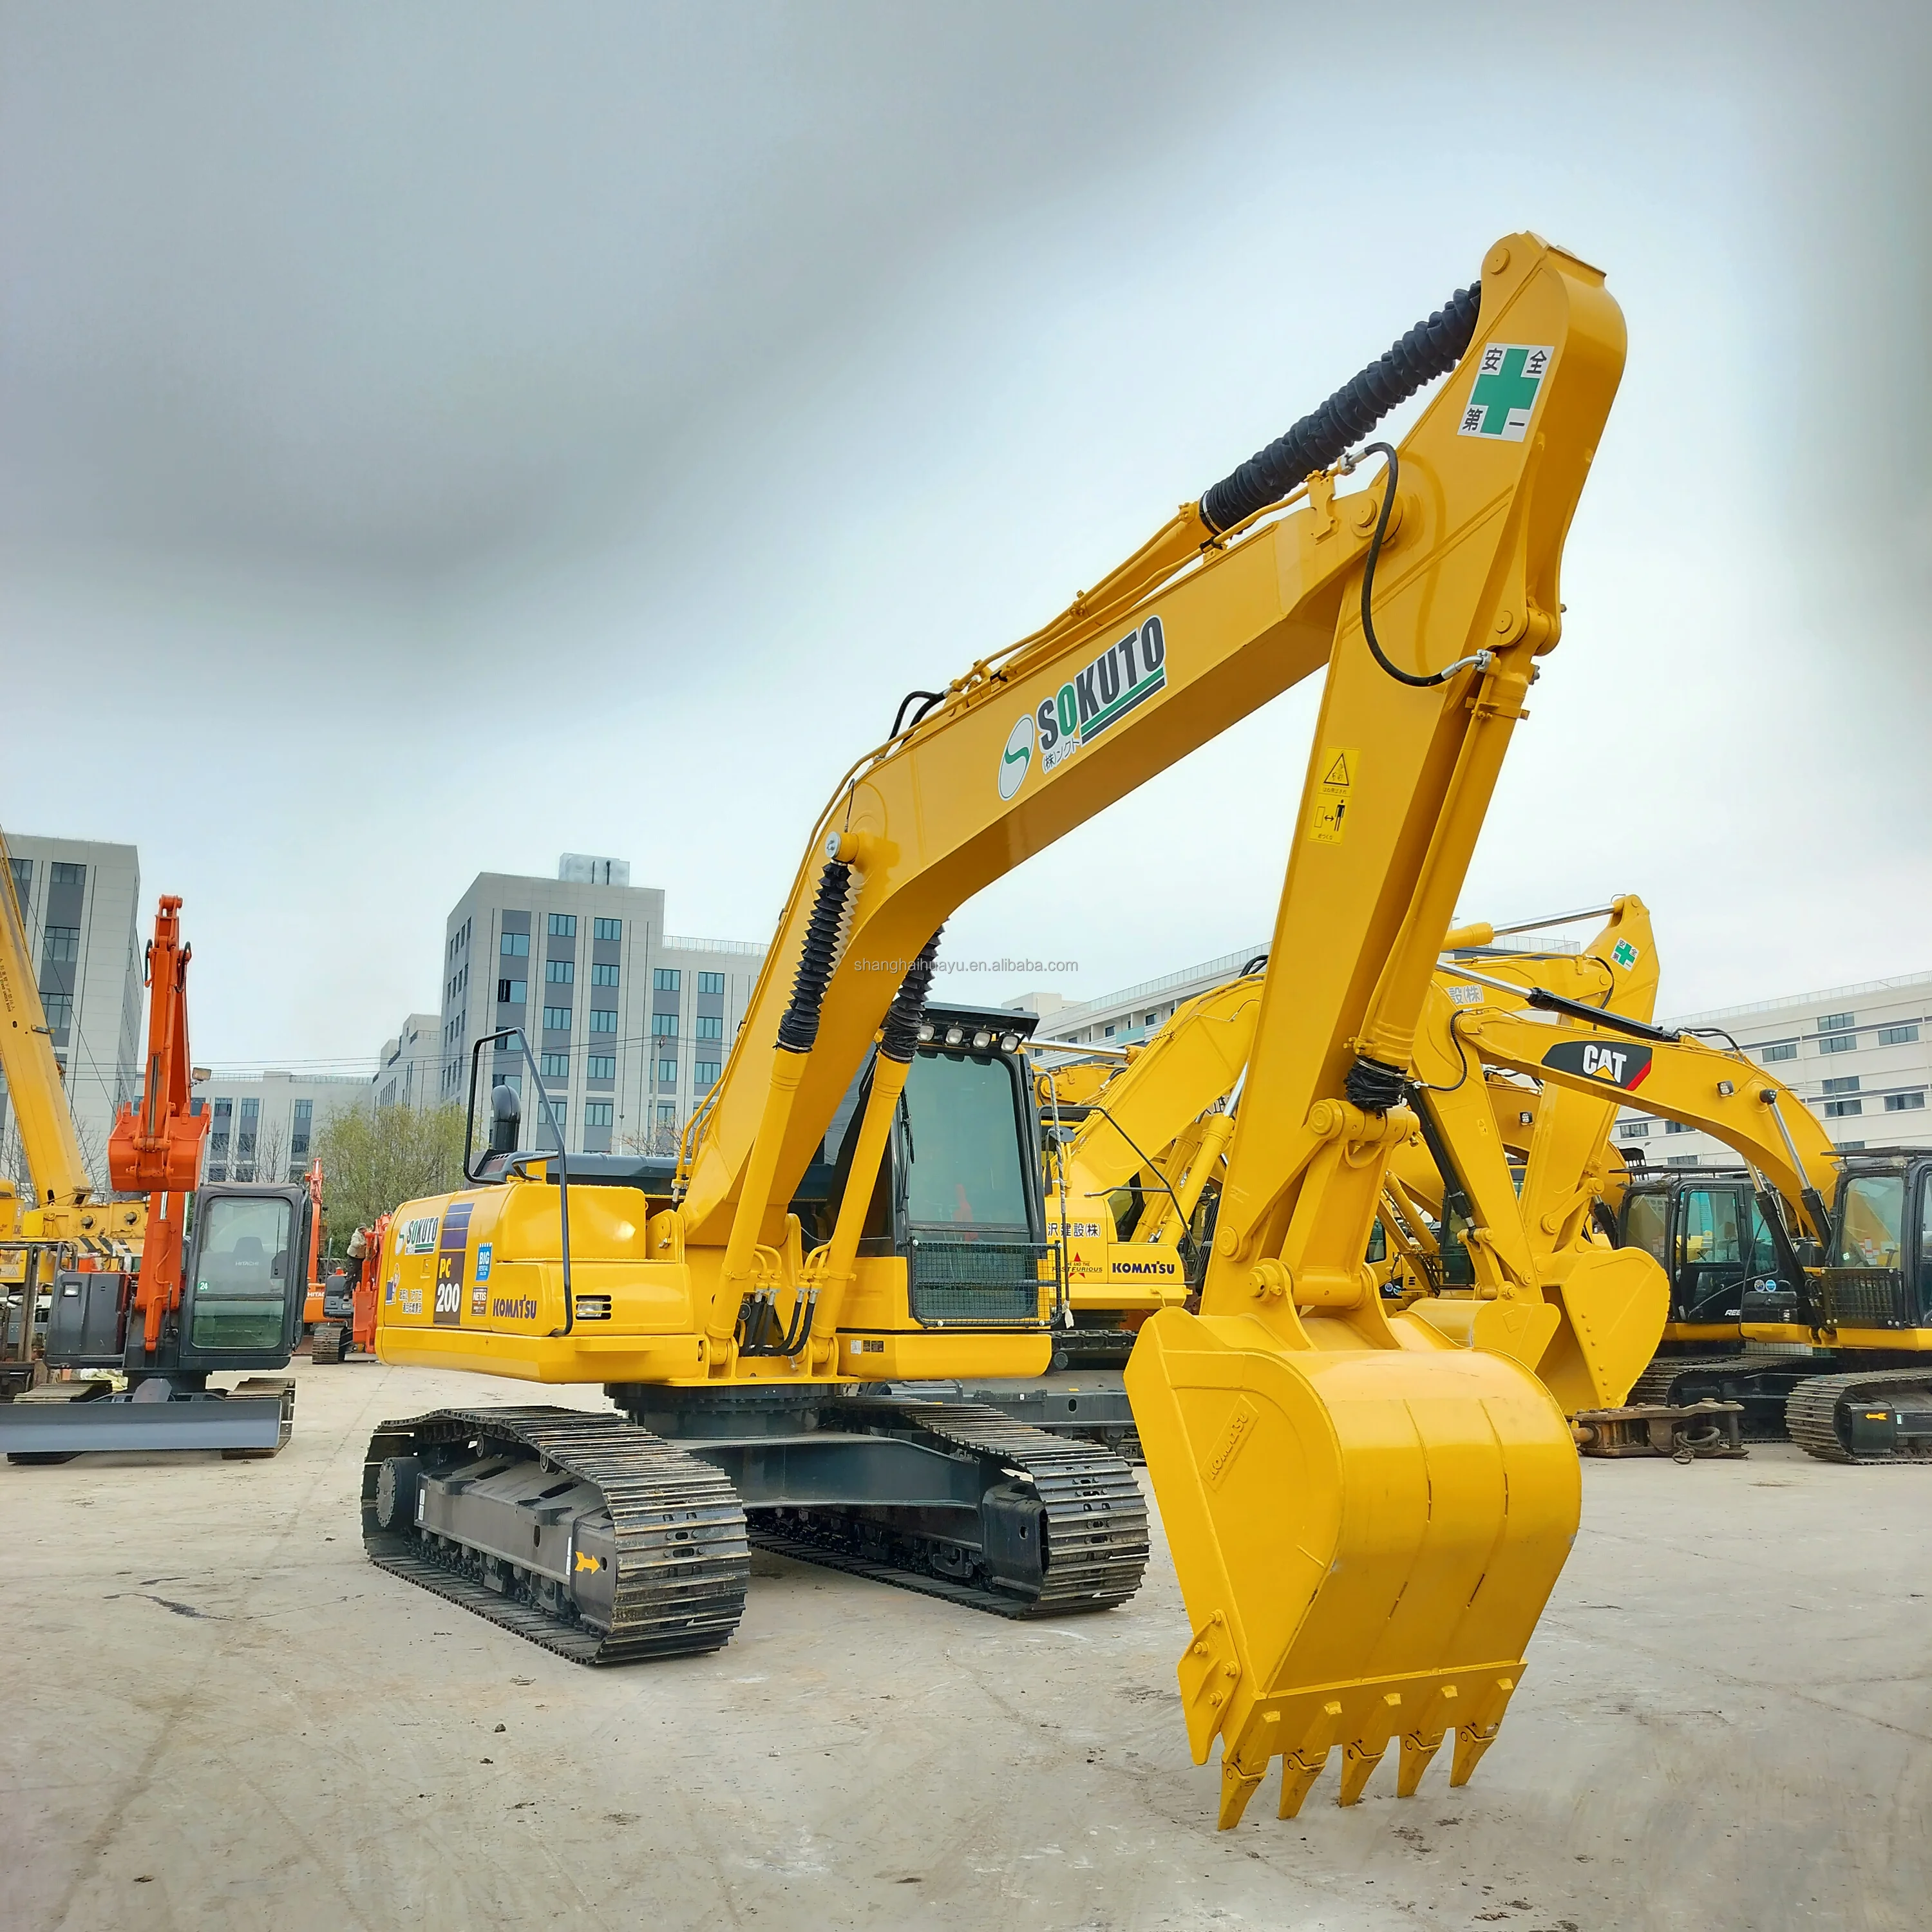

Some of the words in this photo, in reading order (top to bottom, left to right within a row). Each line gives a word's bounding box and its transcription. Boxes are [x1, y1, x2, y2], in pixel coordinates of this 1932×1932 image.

[1037, 616, 1164, 751] SOKUTO
[1583, 1045, 1627, 1083] CAT
[406, 1217, 439, 1244] SOKUTO
[439, 1258, 451, 1278] PC
[479, 1251, 489, 1265] BIG
[1112, 1260, 1175, 1274] KOMATSU
[435, 1283, 460, 1312] 200
[473, 1291, 487, 1302] NETIS
[493, 1294, 537, 1320] KOMATSU
